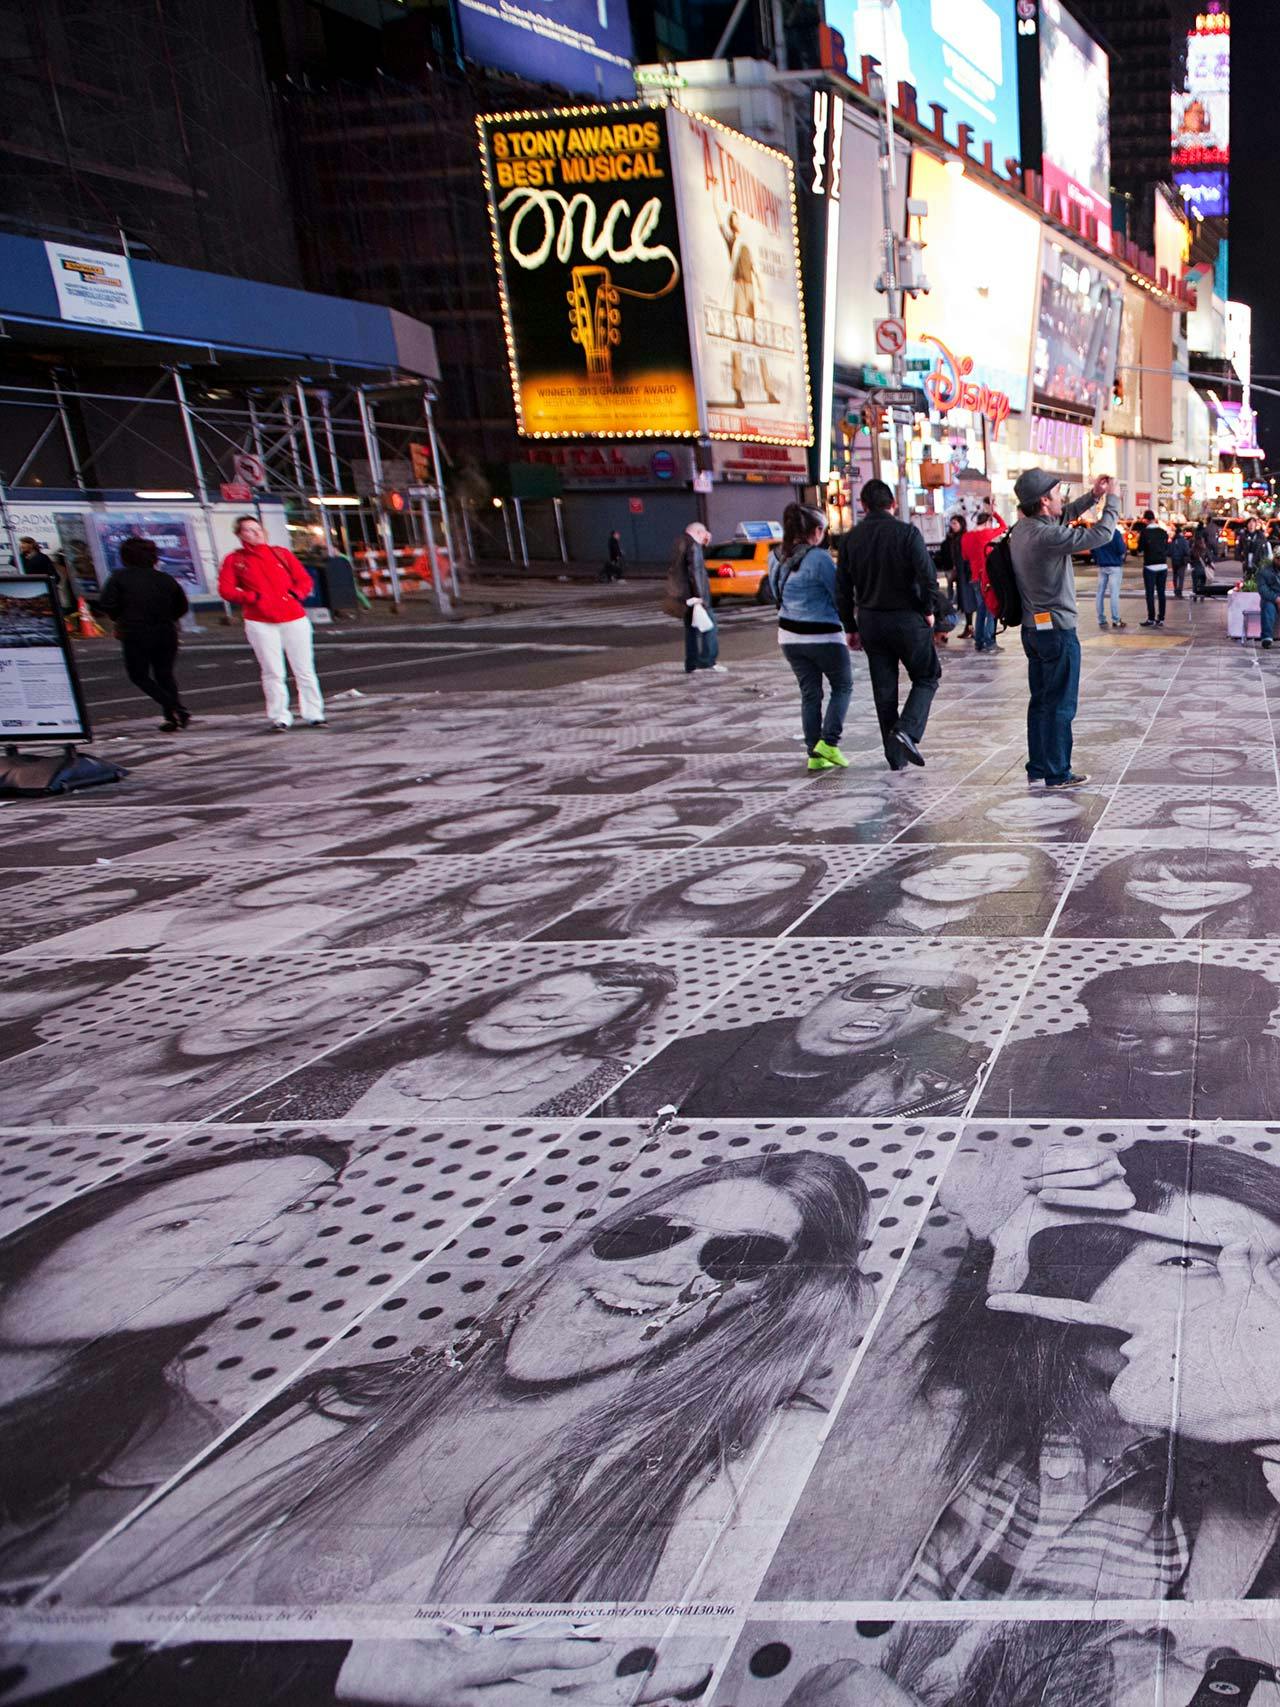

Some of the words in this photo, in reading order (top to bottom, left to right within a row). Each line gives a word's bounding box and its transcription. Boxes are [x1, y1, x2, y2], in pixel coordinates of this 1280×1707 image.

[494, 132, 509, 158] 8
[508, 129, 566, 157] TONY
[567, 121, 661, 153] AWARDS
[497, 160, 556, 188] BEST
[561, 152, 665, 184] MUSICAL
[643, 384, 677, 395] AWARD
